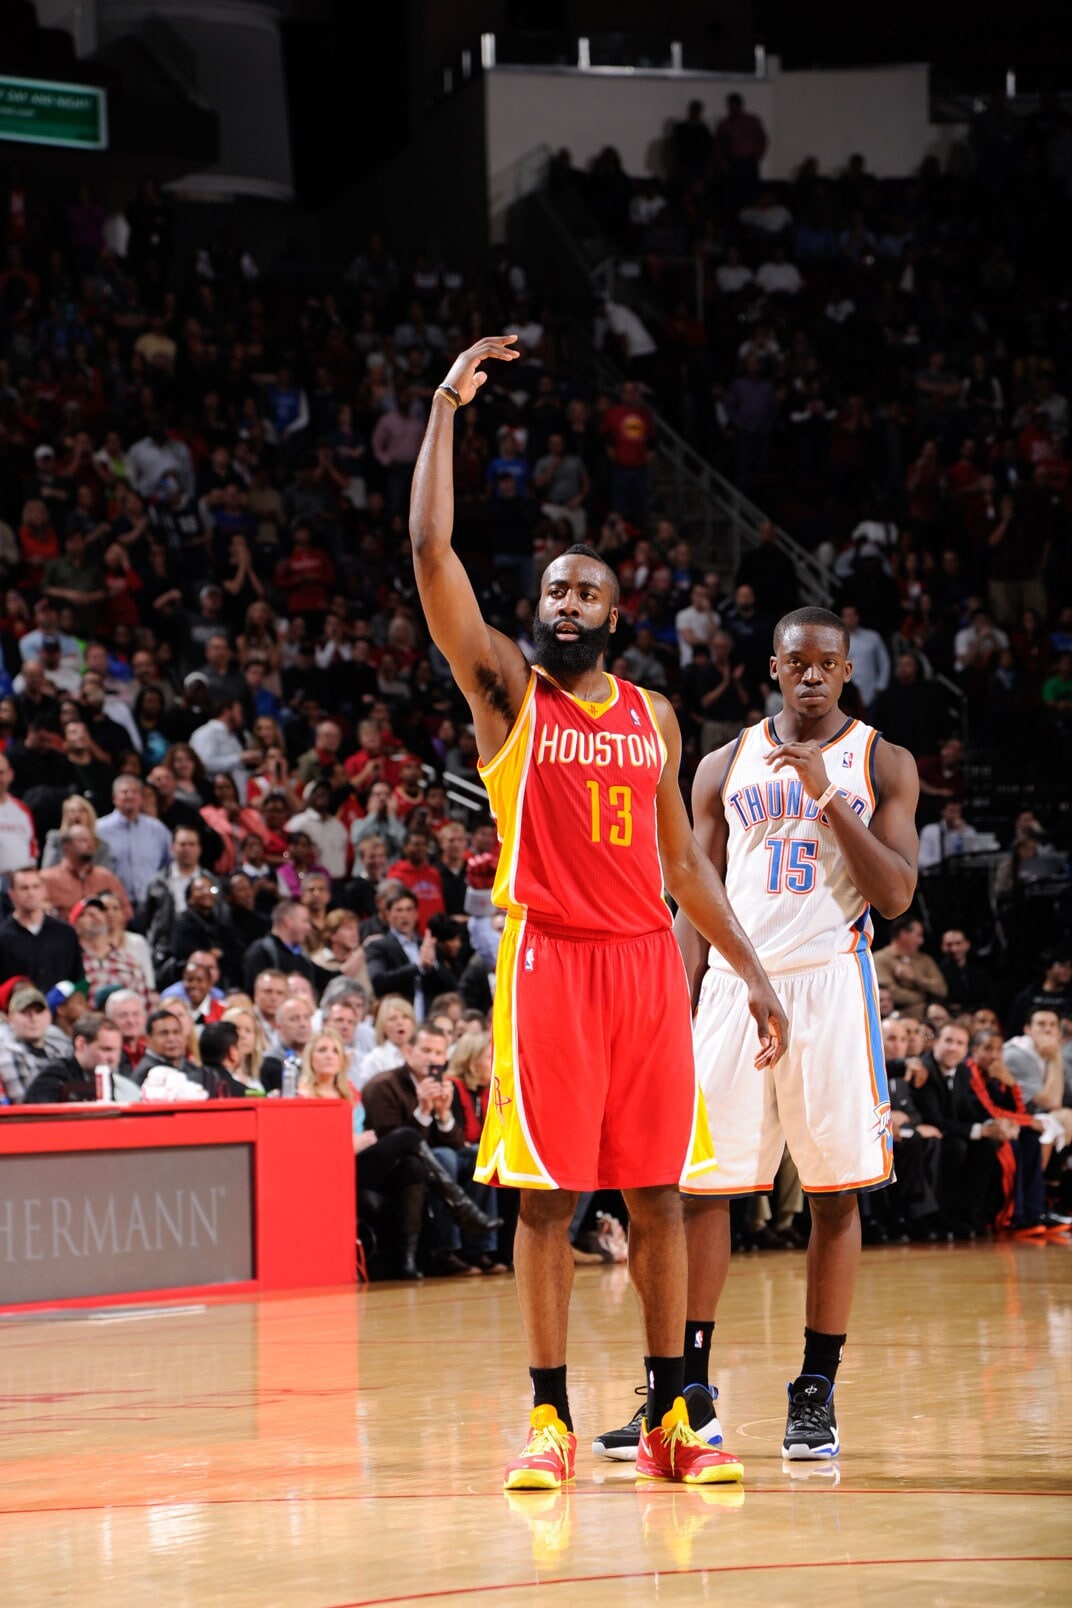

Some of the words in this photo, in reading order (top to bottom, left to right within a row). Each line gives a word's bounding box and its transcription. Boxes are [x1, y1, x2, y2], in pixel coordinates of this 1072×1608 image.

[537, 723, 658, 769] HOUSTON
[586, 780, 633, 847] 13
[729, 778, 868, 832] THUND
[765, 838, 818, 895] 15
